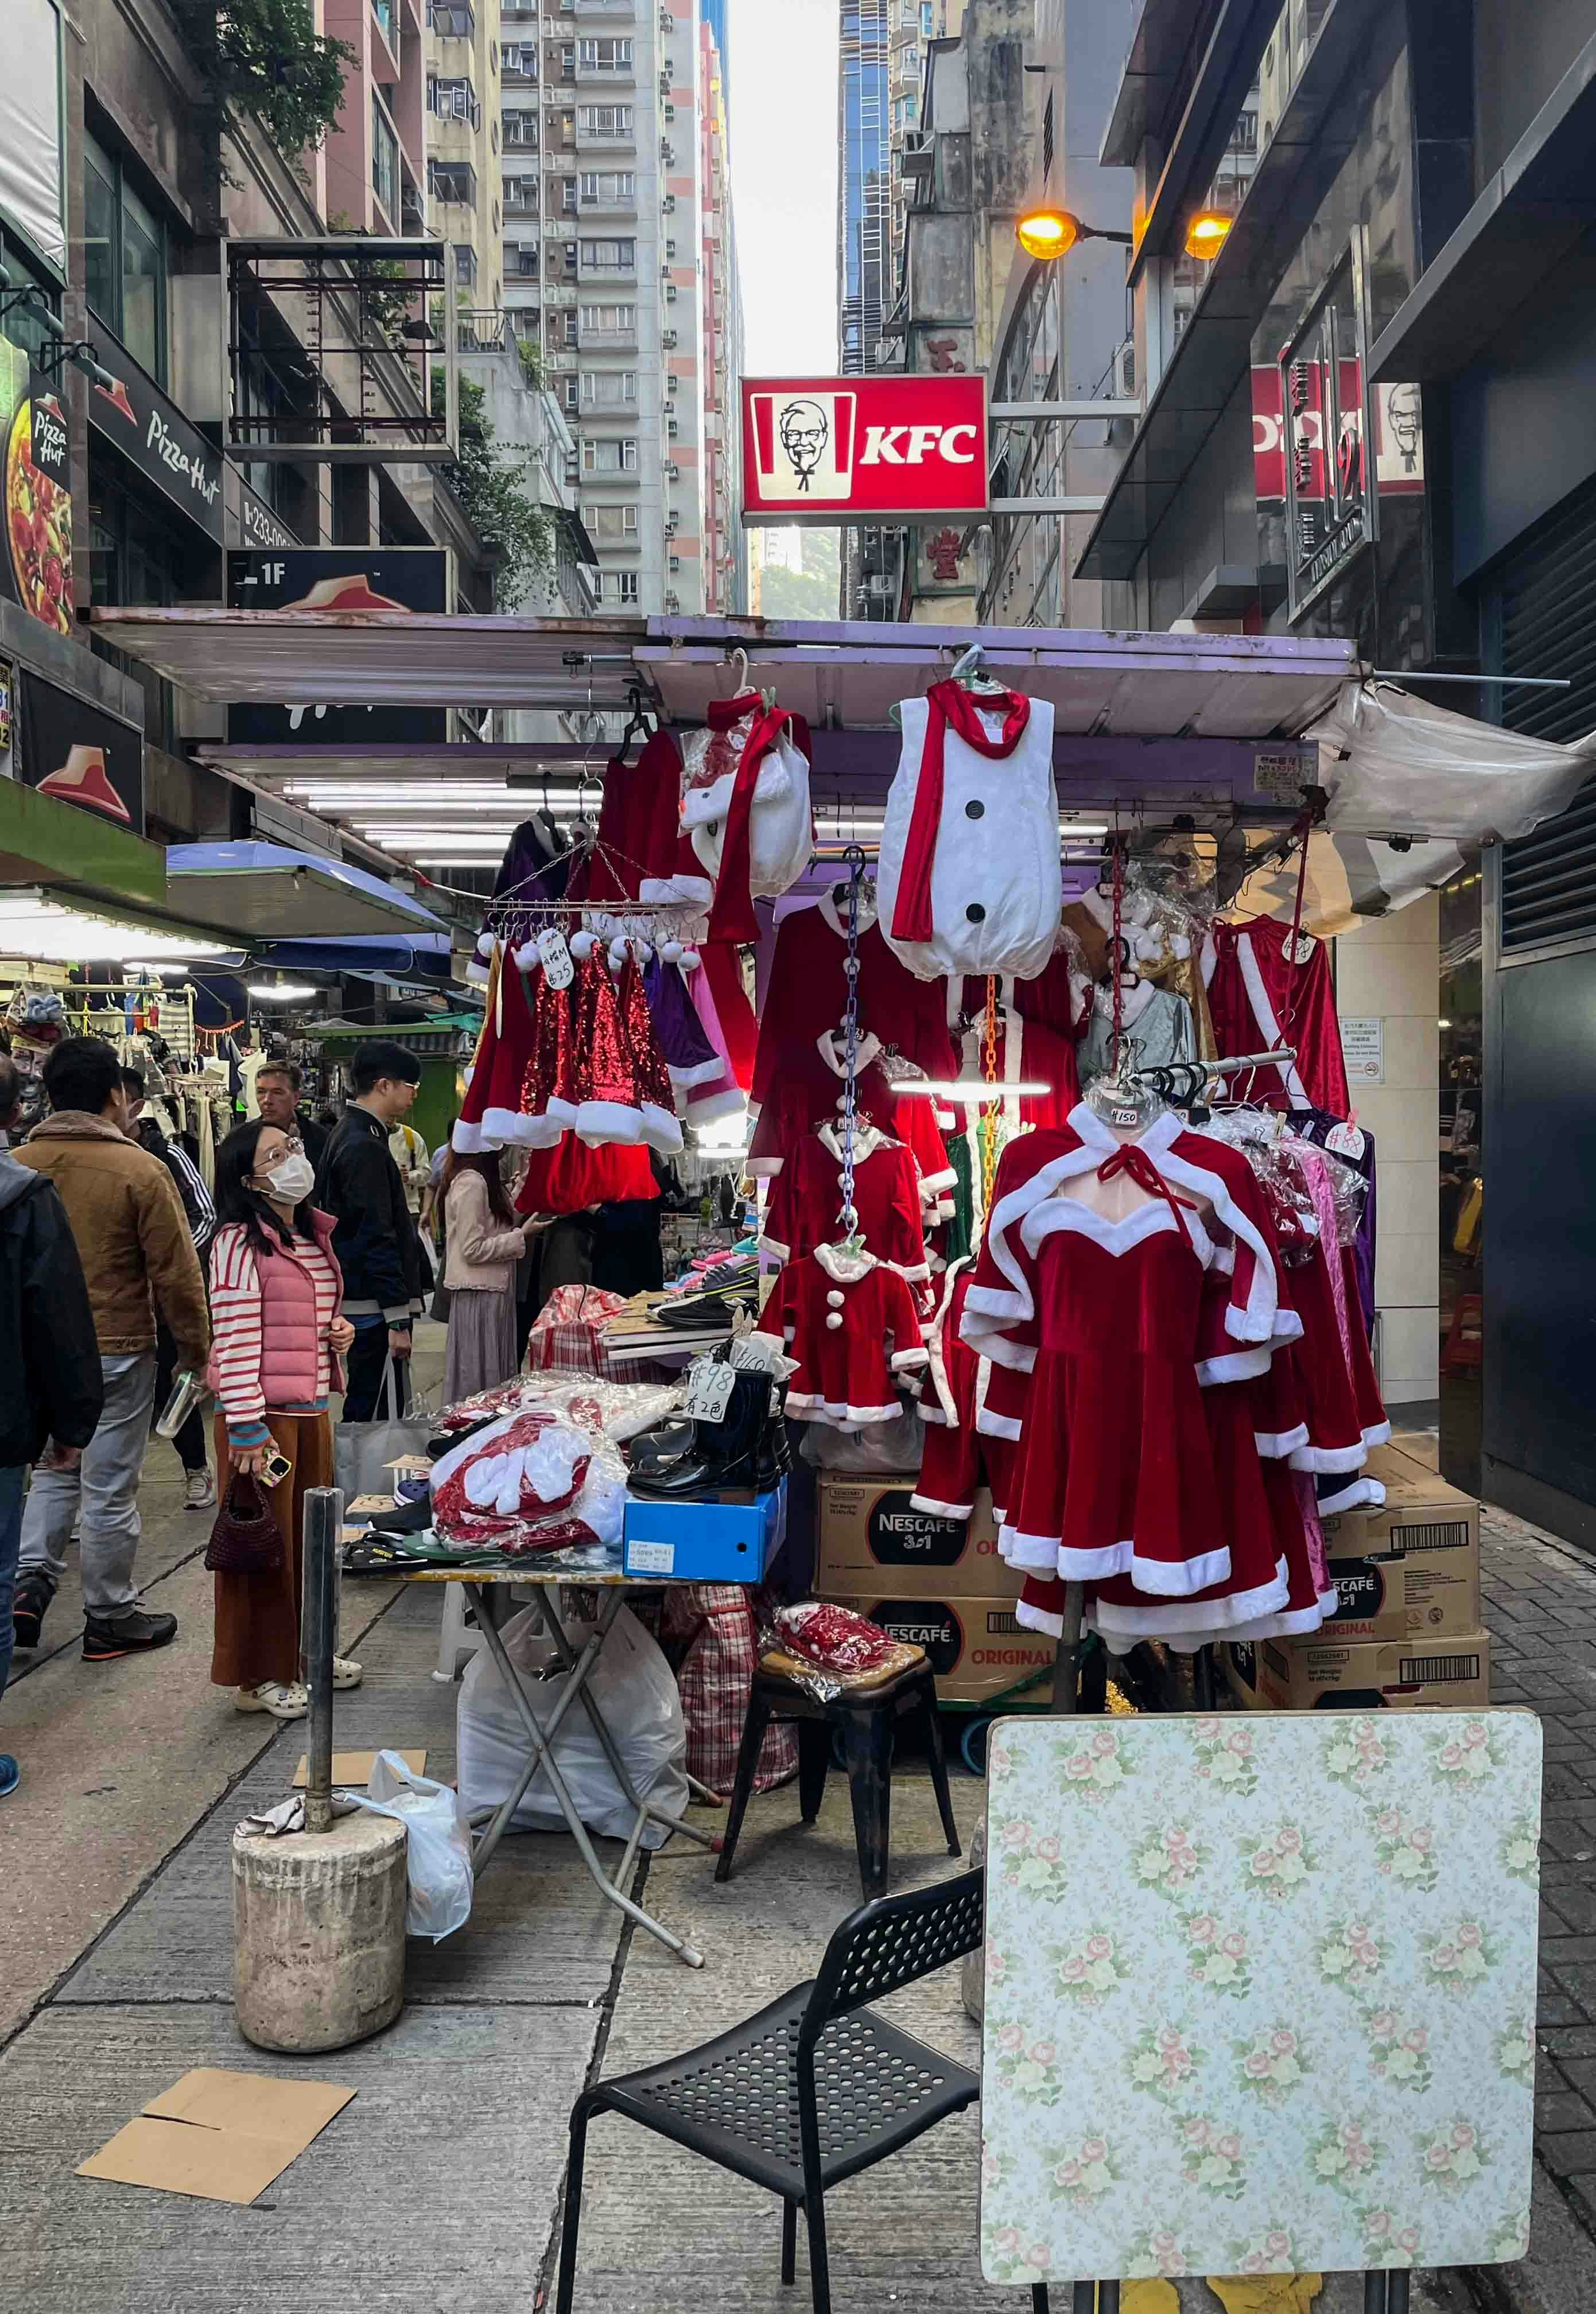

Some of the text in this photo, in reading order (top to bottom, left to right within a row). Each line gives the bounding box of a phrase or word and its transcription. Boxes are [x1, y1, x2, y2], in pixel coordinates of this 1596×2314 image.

[35, 411, 67, 445] Pizza
[40, 439, 66, 468] Hut
[147, 410, 221, 506] Pizza Hut
[859, 424, 977, 465] KFC
[261, 563, 285, 585] 1F
[972, 1648, 1051, 1665] ORIGINAL
